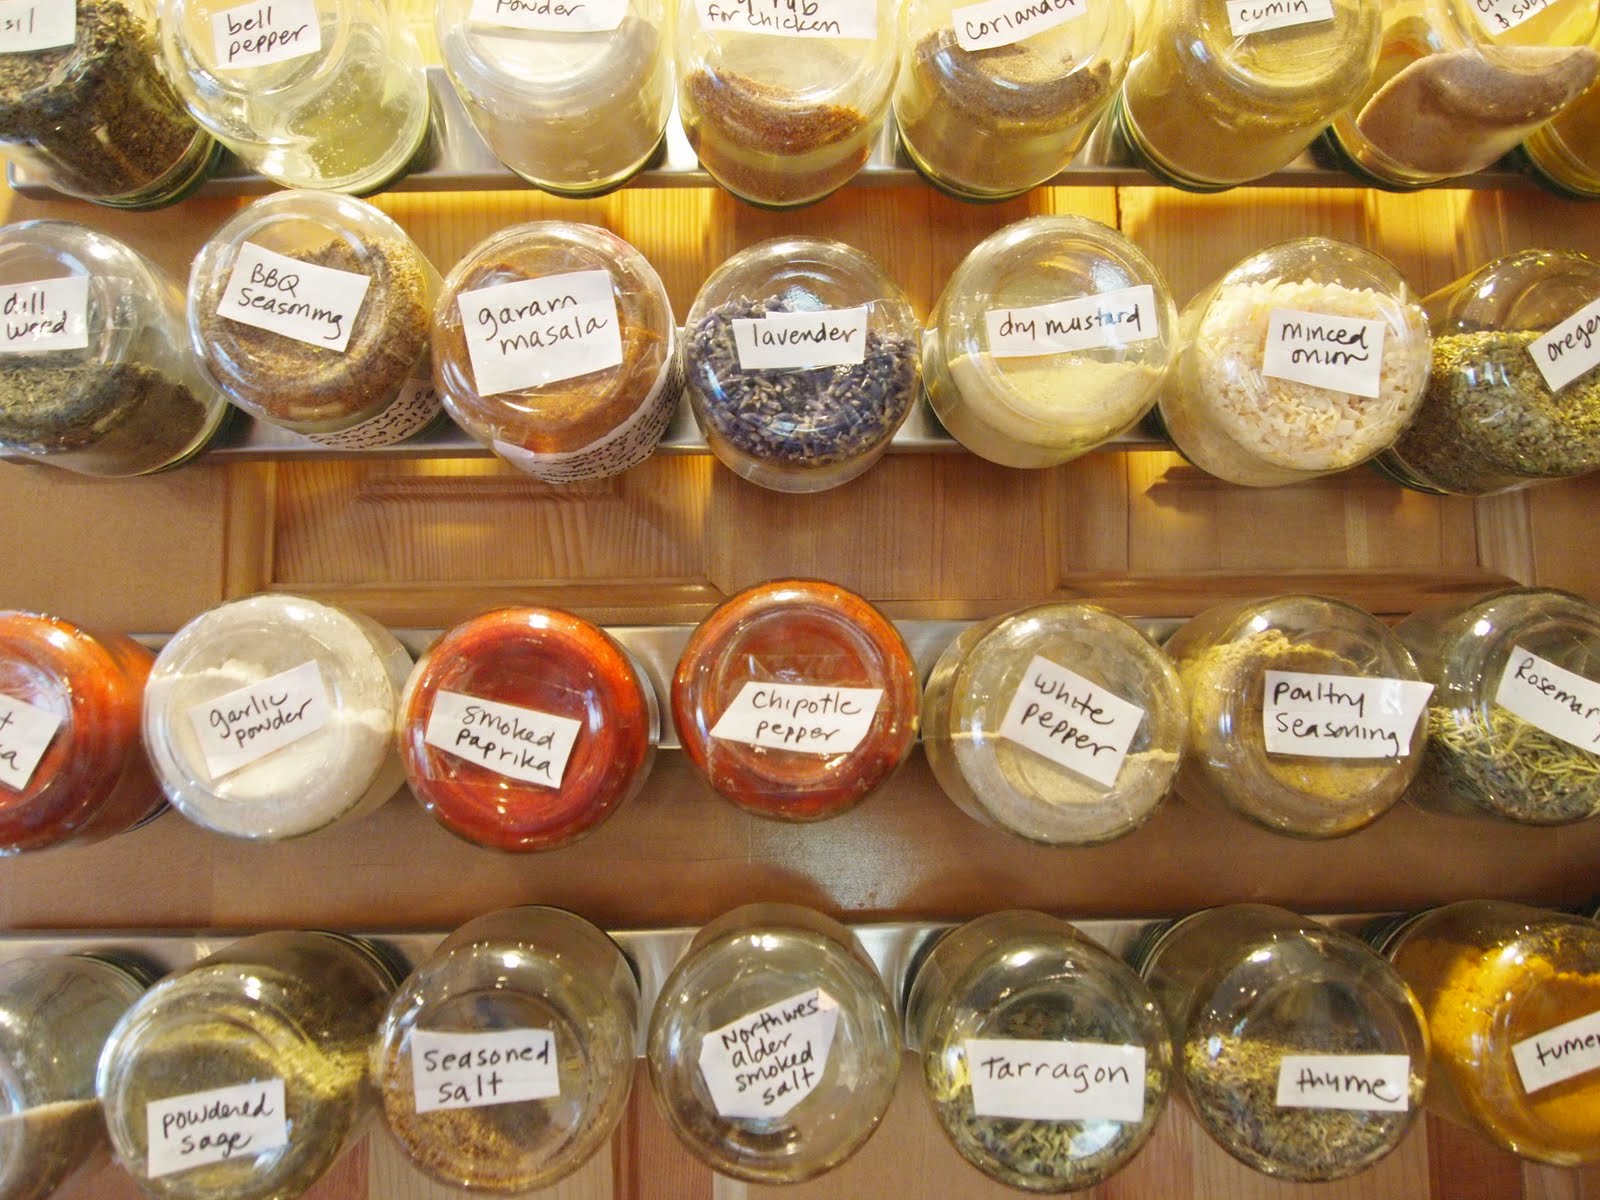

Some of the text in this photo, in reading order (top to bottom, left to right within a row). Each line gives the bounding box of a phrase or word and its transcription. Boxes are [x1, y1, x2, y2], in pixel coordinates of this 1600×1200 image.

[5, 7, 34, 34] sil
[226, 6, 272, 35] bell
[708, 4, 739, 22] for
[748, 11, 841, 35] chicken
[1239, 0, 1309, 22] cumin
[229, 24, 309, 63] pepper
[250, 262, 300, 299] BBQ
[4, 291, 46, 316] dill
[478, 295, 578, 341] garam
[999, 304, 1142, 340] dry mustard
[499, 315, 608, 356] masala
[752, 322, 857, 347] lavender
[209, 693, 288, 740] garlic
[1513, 657, 1600, 743] Rosemar
[235, 698, 313, 749] powder
[720, 991, 820, 1050] Northwes
[732, 1032, 793, 1069] alder
[735, 1040, 814, 1093] smoked
[761, 1066, 815, 1107] salt
[980, 1056, 1129, 1094] Tarragon
[1295, 1067, 1402, 1104] thyme
[162, 1092, 275, 1140] powdered
[181, 1131, 253, 1158] sage
